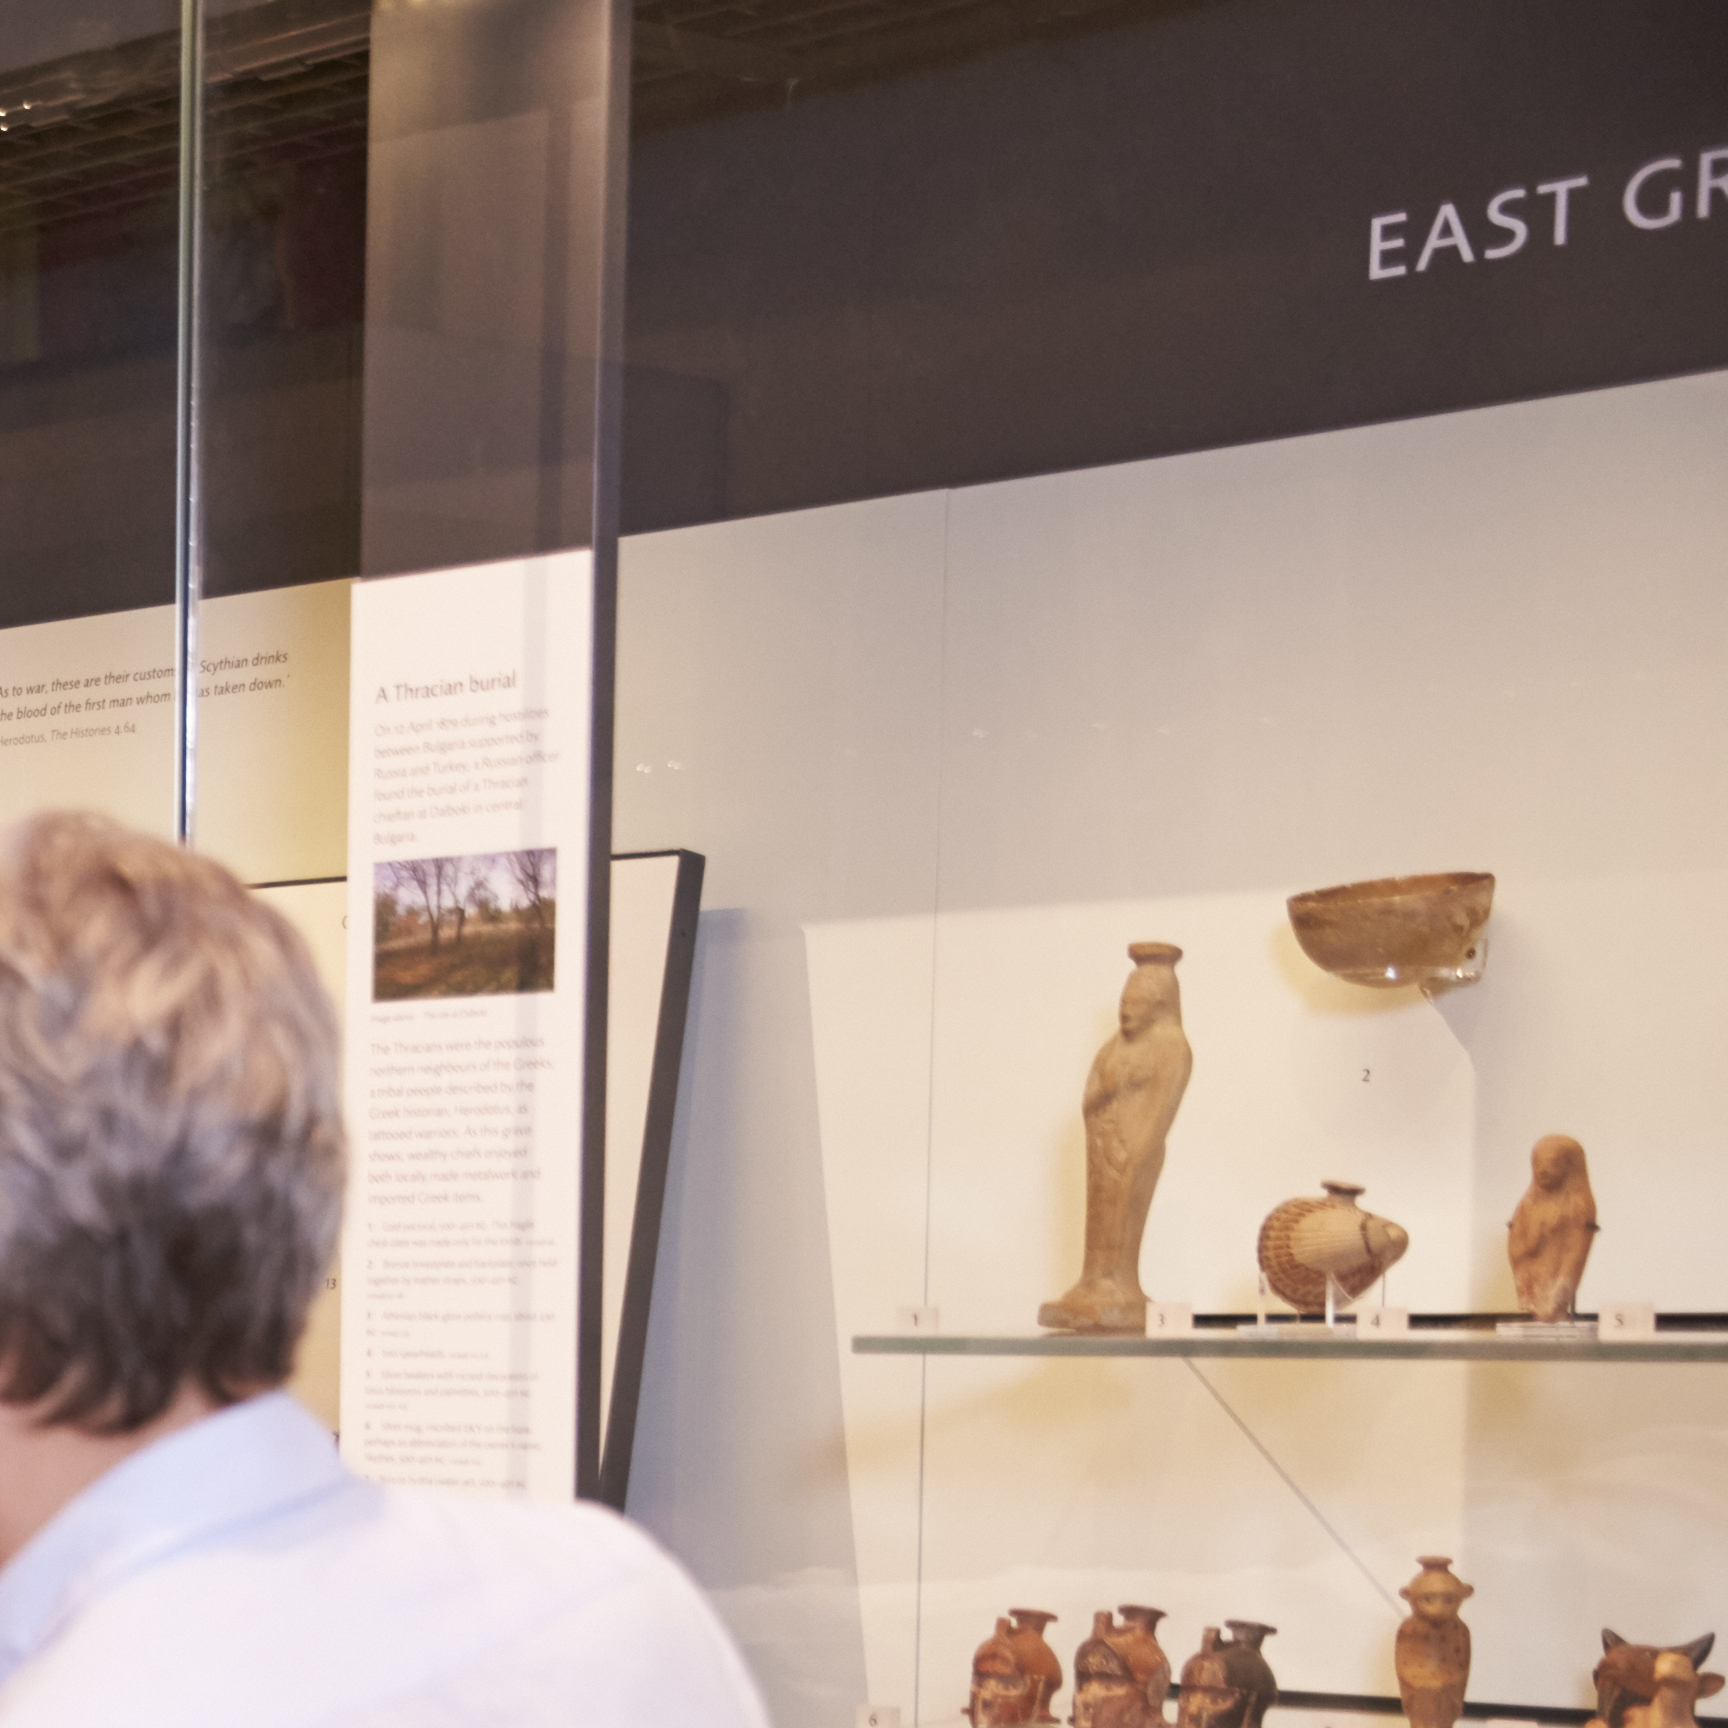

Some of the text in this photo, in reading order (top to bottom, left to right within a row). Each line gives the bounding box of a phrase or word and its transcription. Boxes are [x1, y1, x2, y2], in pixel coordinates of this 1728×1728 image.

[1370, 175, 1589, 281] EAST
[12, 685, 23, 697] to
[26, 683, 48, 695] war,
[51, 678, 81, 692] these
[83, 677, 102, 688] are
[104, 671, 131, 686] their
[132, 666, 176, 682] custom
[200, 657, 249, 676] Scythian
[251, 650, 288, 667] drinks
[376, 670, 517, 703] A Thracian burial
[16, 703, 48, 720] blood
[50, 701, 63, 716] of
[64, 700, 82, 714] the
[84, 698, 107, 711] first
[108, 697, 133, 709] man
[135, 691, 172, 706] whom
[213, 681, 246, 696] taken
[1362, 1068, 1371, 1083] 2
[325, 1278, 337, 1291] 13
[1615, 1313, 1625, 1327] 5
[869, 1713, 878, 1726] 6
